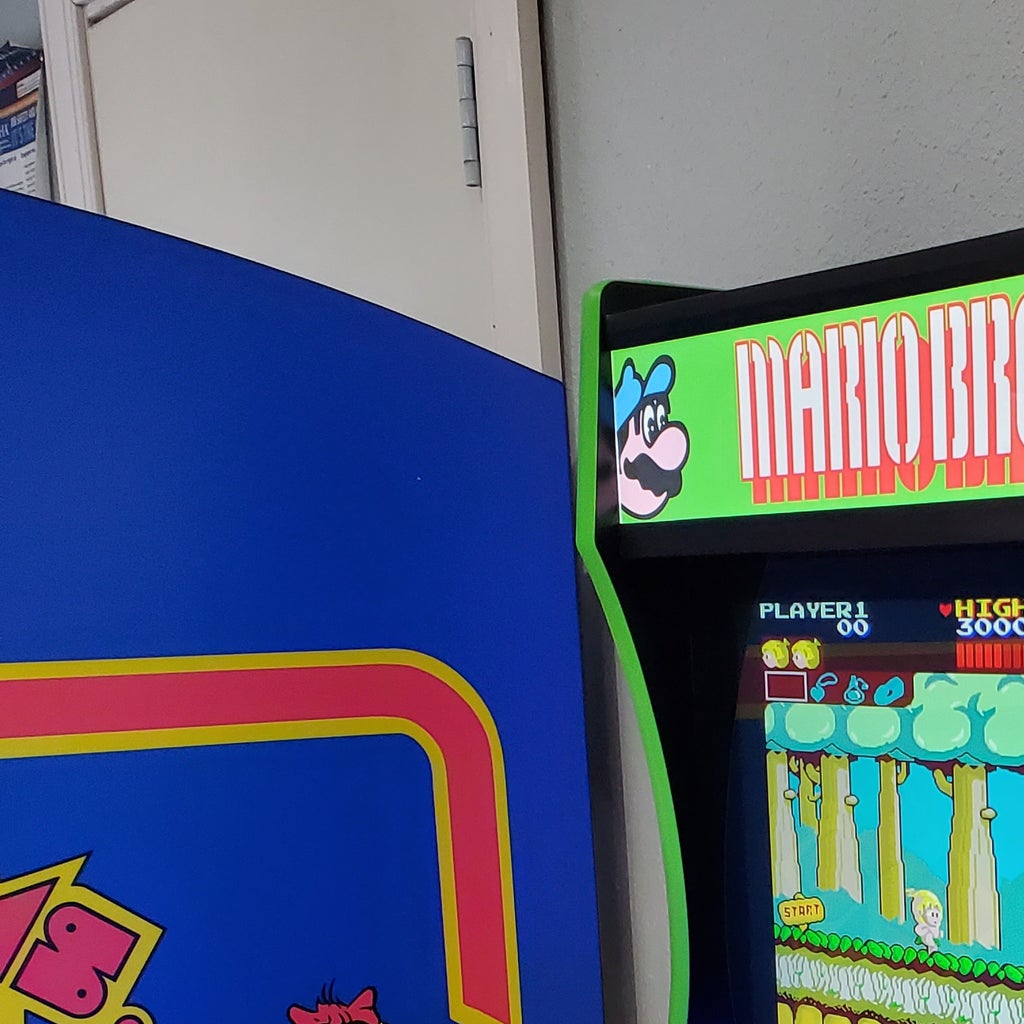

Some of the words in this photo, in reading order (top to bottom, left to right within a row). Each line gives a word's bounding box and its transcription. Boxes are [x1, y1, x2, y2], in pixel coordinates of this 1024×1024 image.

[735, 311, 924, 498] MARIO
[836, 619, 871, 637] 00
[784, 904, 820, 918] START
